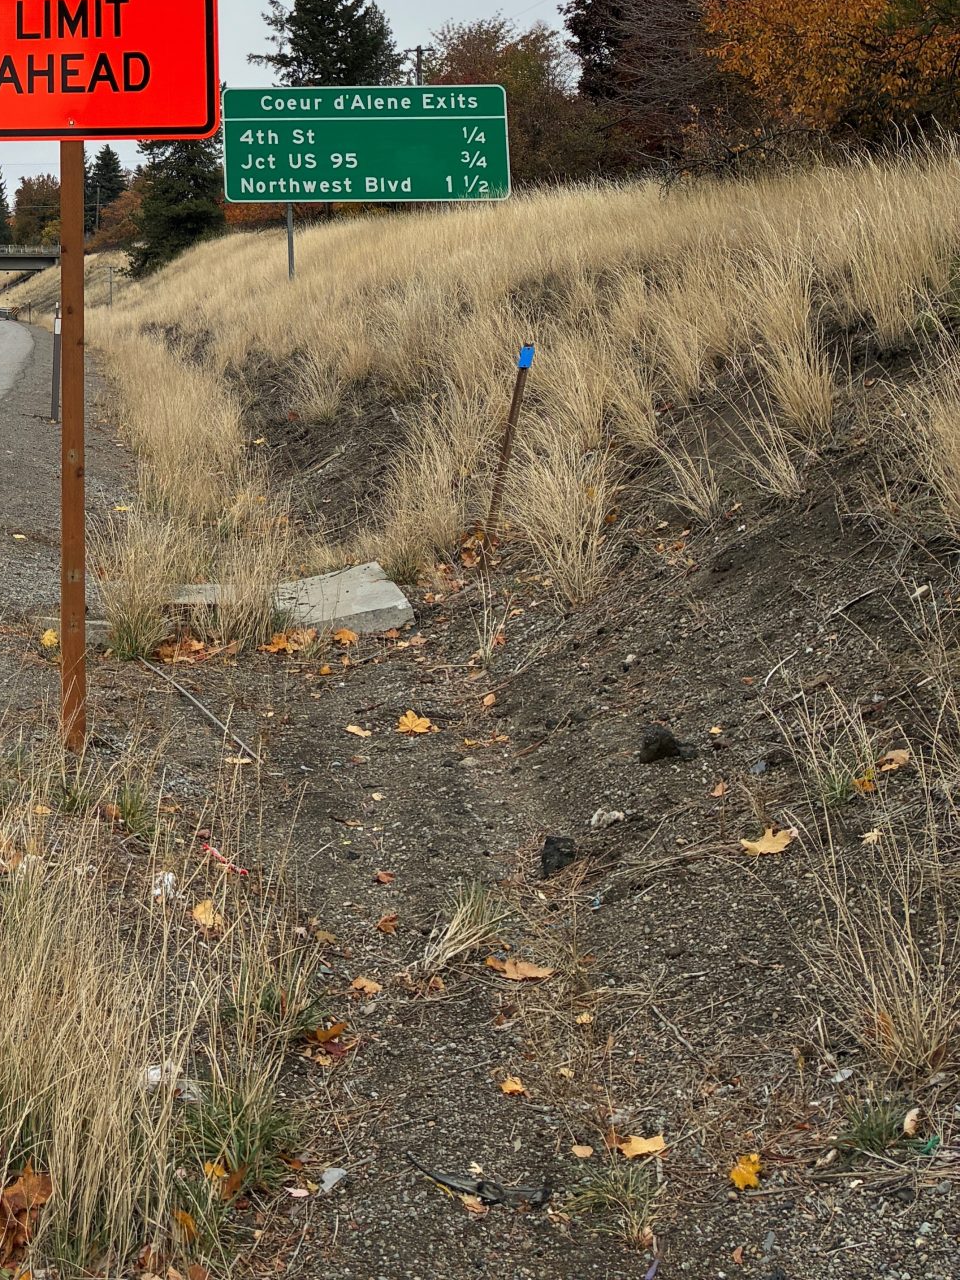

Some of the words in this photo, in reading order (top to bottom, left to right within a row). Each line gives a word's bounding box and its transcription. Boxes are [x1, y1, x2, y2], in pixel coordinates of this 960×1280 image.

[260, 95, 322, 110] Coeur
[333, 94, 411, 110] d'Alene
[422, 93, 478, 109] Exits
[239, 129, 279, 144] 4th
[292, 129, 315, 144] St
[240, 154, 276, 169] Jct
[288, 153, 317, 169] US
[330, 153, 358, 168] 95
[240, 177, 352, 193] Northwest
[365, 177, 412, 192] Blvd
